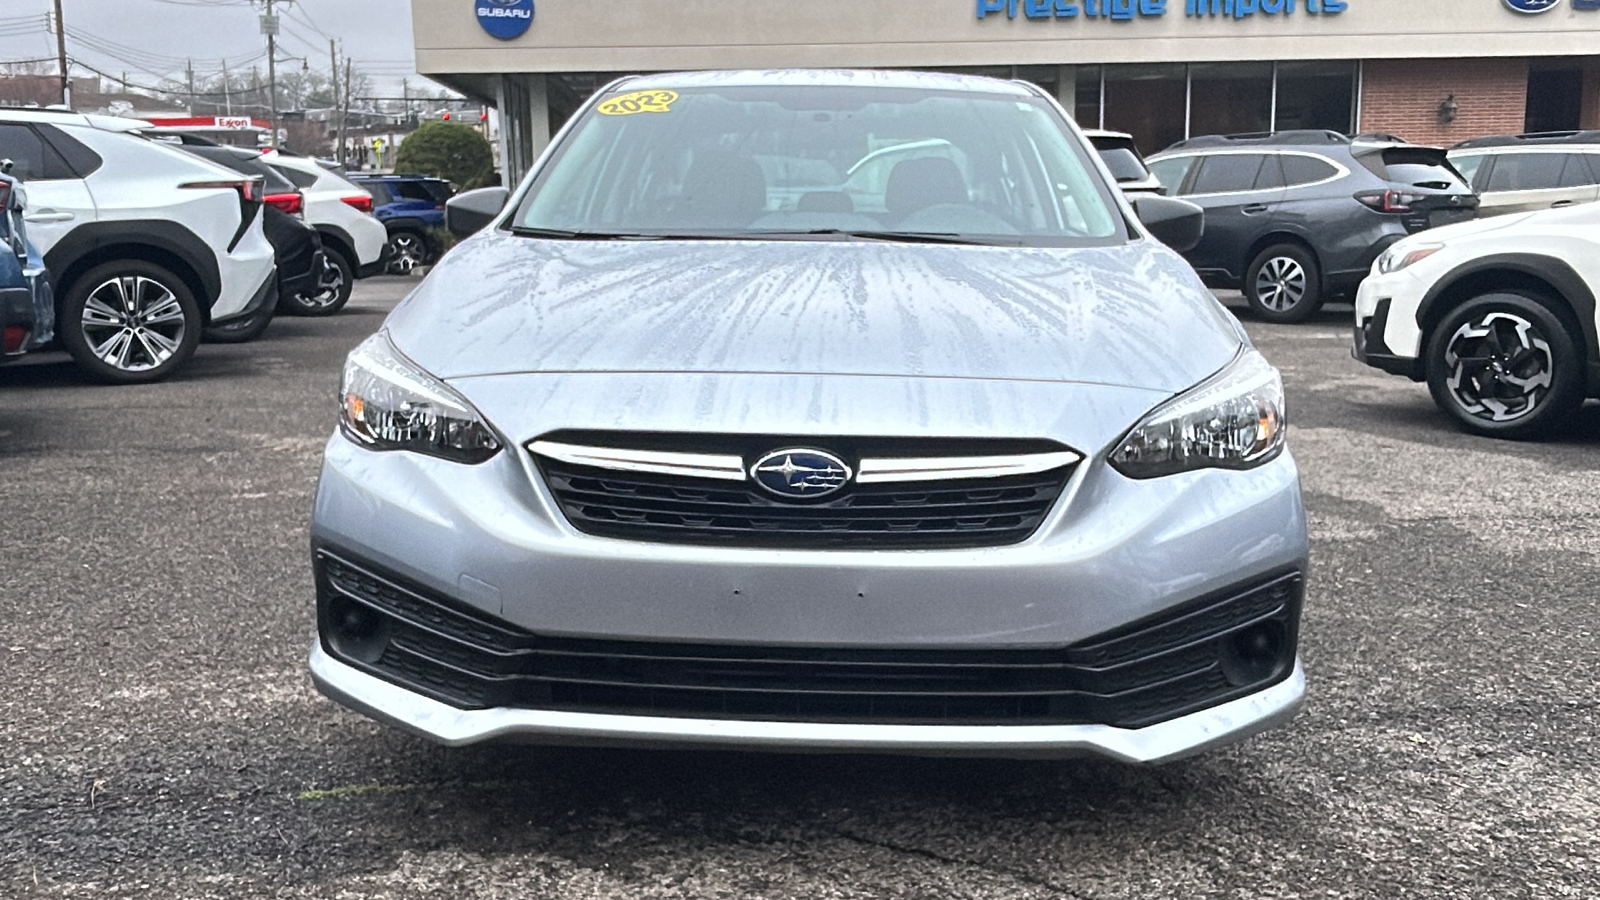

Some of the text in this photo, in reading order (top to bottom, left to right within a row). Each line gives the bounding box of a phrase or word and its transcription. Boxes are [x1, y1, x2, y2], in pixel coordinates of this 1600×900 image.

[477, 7, 531, 18] SUBARU
[603, 91, 674, 113] 2023
[218, 118, 248, 129] Exxon
